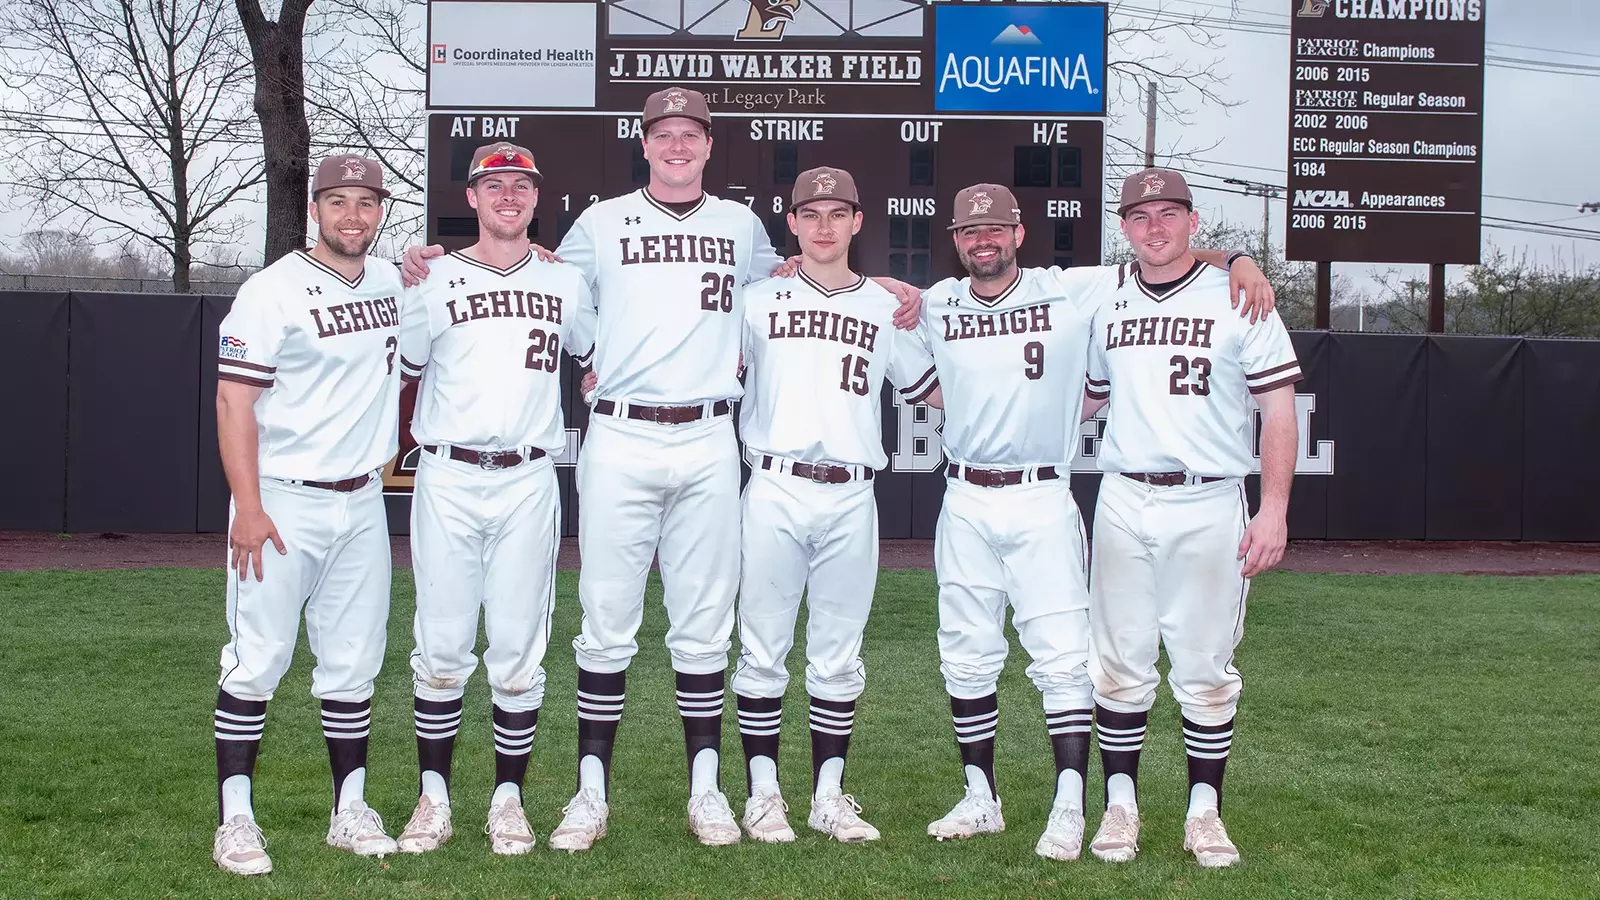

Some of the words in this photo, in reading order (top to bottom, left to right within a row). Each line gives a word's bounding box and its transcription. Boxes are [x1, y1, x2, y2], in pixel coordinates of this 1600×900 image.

[1335, 0, 1481, 21] CHAMPIONS
[1297, 38, 1359, 48] PATRIOT
[1297, 47, 1359, 57] LEAGUE
[1363, 43, 1435, 60] Champions
[453, 48, 542, 61] Coordinated
[547, 49, 594, 61] Health
[609, 55, 630, 78] J.
[636, 54, 714, 78] DAVID
[720, 55, 833, 79] WALKER
[842, 56, 921, 80] FIELD
[939, 52, 1093, 95] AQUAFINA
[1296, 67, 1329, 81] 2006
[1337, 67, 1370, 82] 2015
[723, 88, 784, 110] Legacy
[787, 88, 826, 105] Park
[1296, 89, 1358, 99] PATRIOT
[1296, 98, 1357, 108] LEAGUE
[1363, 91, 1414, 109] Regular
[1418, 93, 1466, 108] Season
[450, 117, 476, 138] AT
[481, 117, 520, 138] BAT
[617, 118, 644, 139] BA
[750, 119, 824, 141] STRIKE
[900, 121, 943, 143] OUT
[1294, 114, 1328, 129] 2002
[1335, 115, 1368, 130] 2006
[1033, 123, 1068, 145] H/E
[1293, 138, 1316, 152] ECC
[1320, 138, 1364, 156] Regular
[1368, 139, 1410, 155] Season
[1413, 141, 1477, 158] Champions
[1293, 162, 1326, 177] 1984
[561, 194, 570, 212] 1
[772, 196, 783, 213] 8
[887, 198, 936, 216] RUNS
[1047, 200, 1082, 218] ERR
[1293, 190, 1350, 208] NCAA
[1361, 191, 1446, 209] Appearances
[1292, 214, 1325, 229] 2006
[1333, 215, 1366, 230] 2015
[619, 234, 736, 266] LEHIGH
[700, 271, 735, 313] 26
[310, 296, 399, 339] LEHIGH
[446, 289, 563, 326] LEHIGH
[768, 310, 879, 353] LEHIGH
[942, 303, 1052, 342] LEHIGH
[1105, 316, 1215, 351] LEHIGH
[524, 328, 560, 374] 29
[1024, 341, 1045, 380] 9
[840, 353, 870, 397] 15
[1169, 354, 1213, 397] 23
